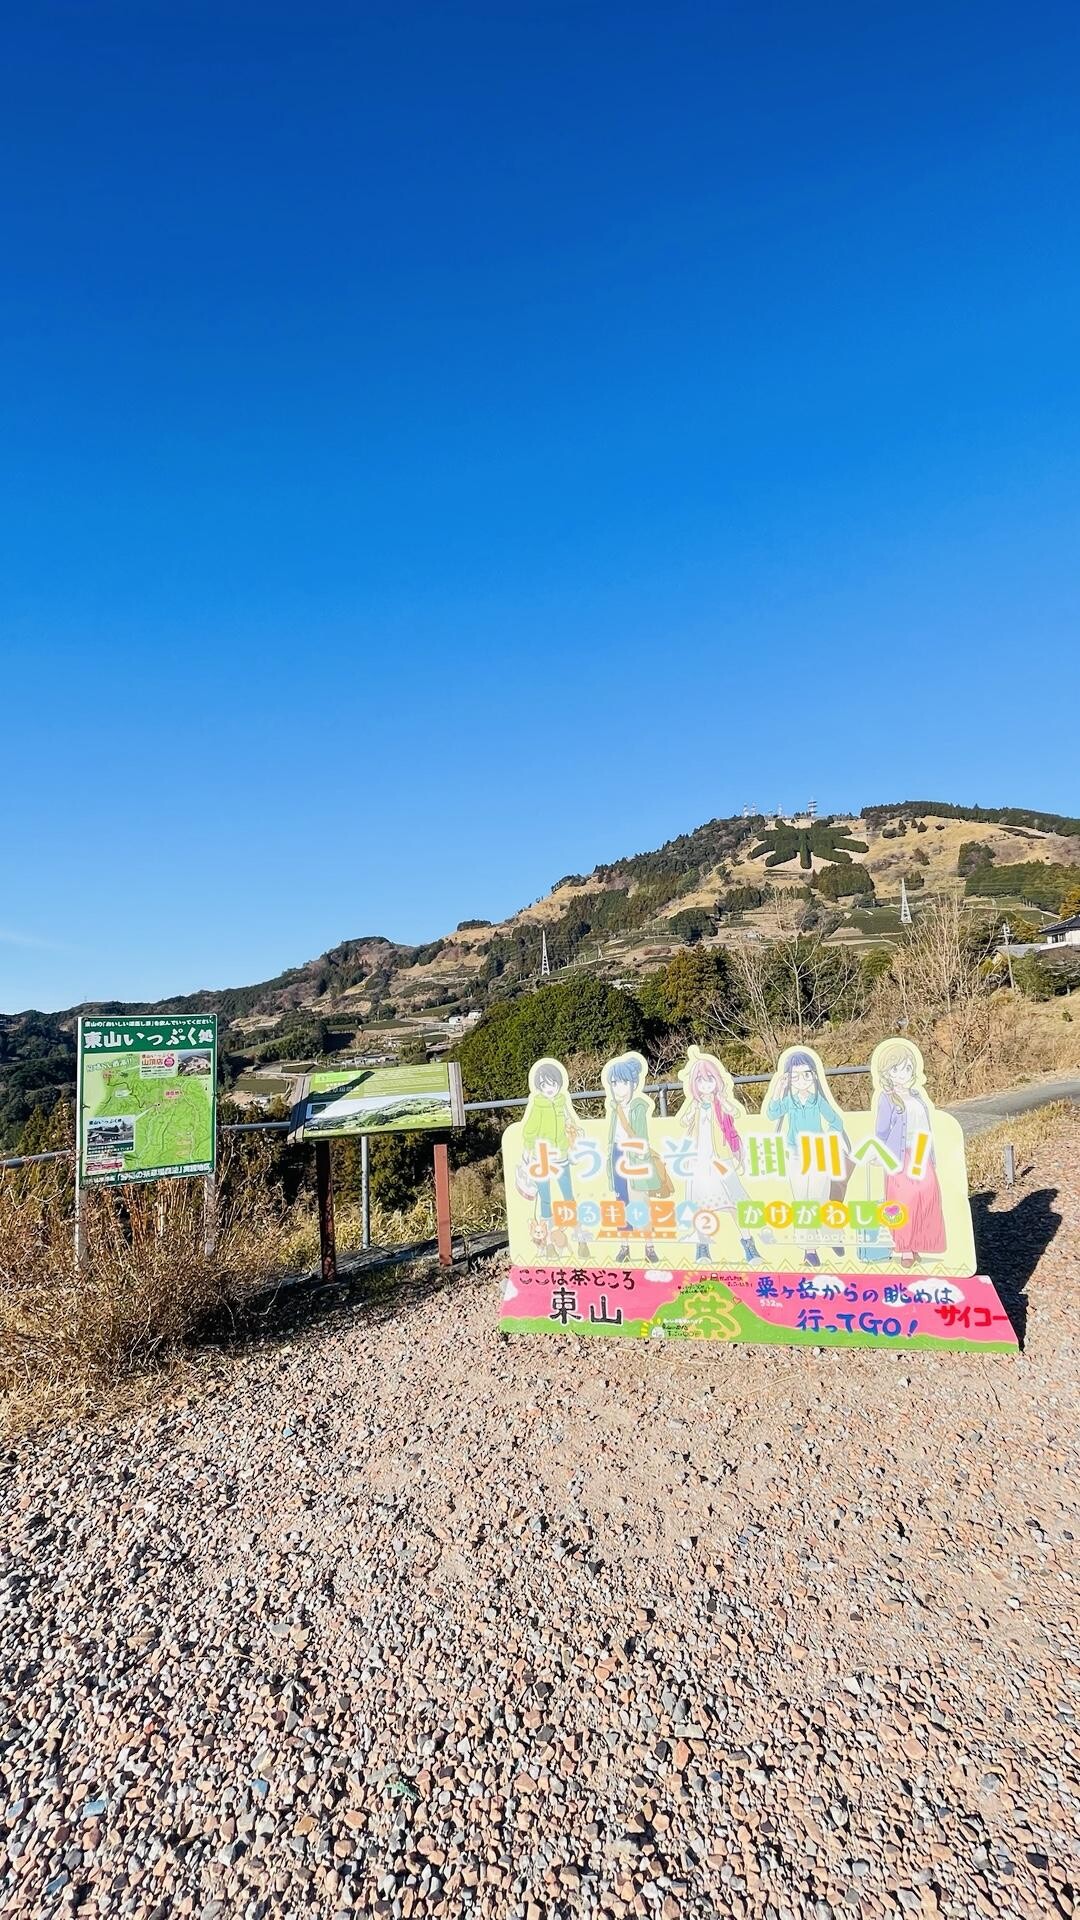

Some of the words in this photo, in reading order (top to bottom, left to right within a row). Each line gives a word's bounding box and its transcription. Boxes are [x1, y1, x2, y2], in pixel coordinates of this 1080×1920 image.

[84, 1027, 214, 1048] 東山いっぷく処
[743, 1205, 873, 1225] かけがわし
[519, 1268, 635, 1290] ここは茶どころ
[549, 1287, 622, 1324] 東山
[934, 1305, 1008, 1328] サイコー
[796, 1308, 919, 1337] 行ってGO!
